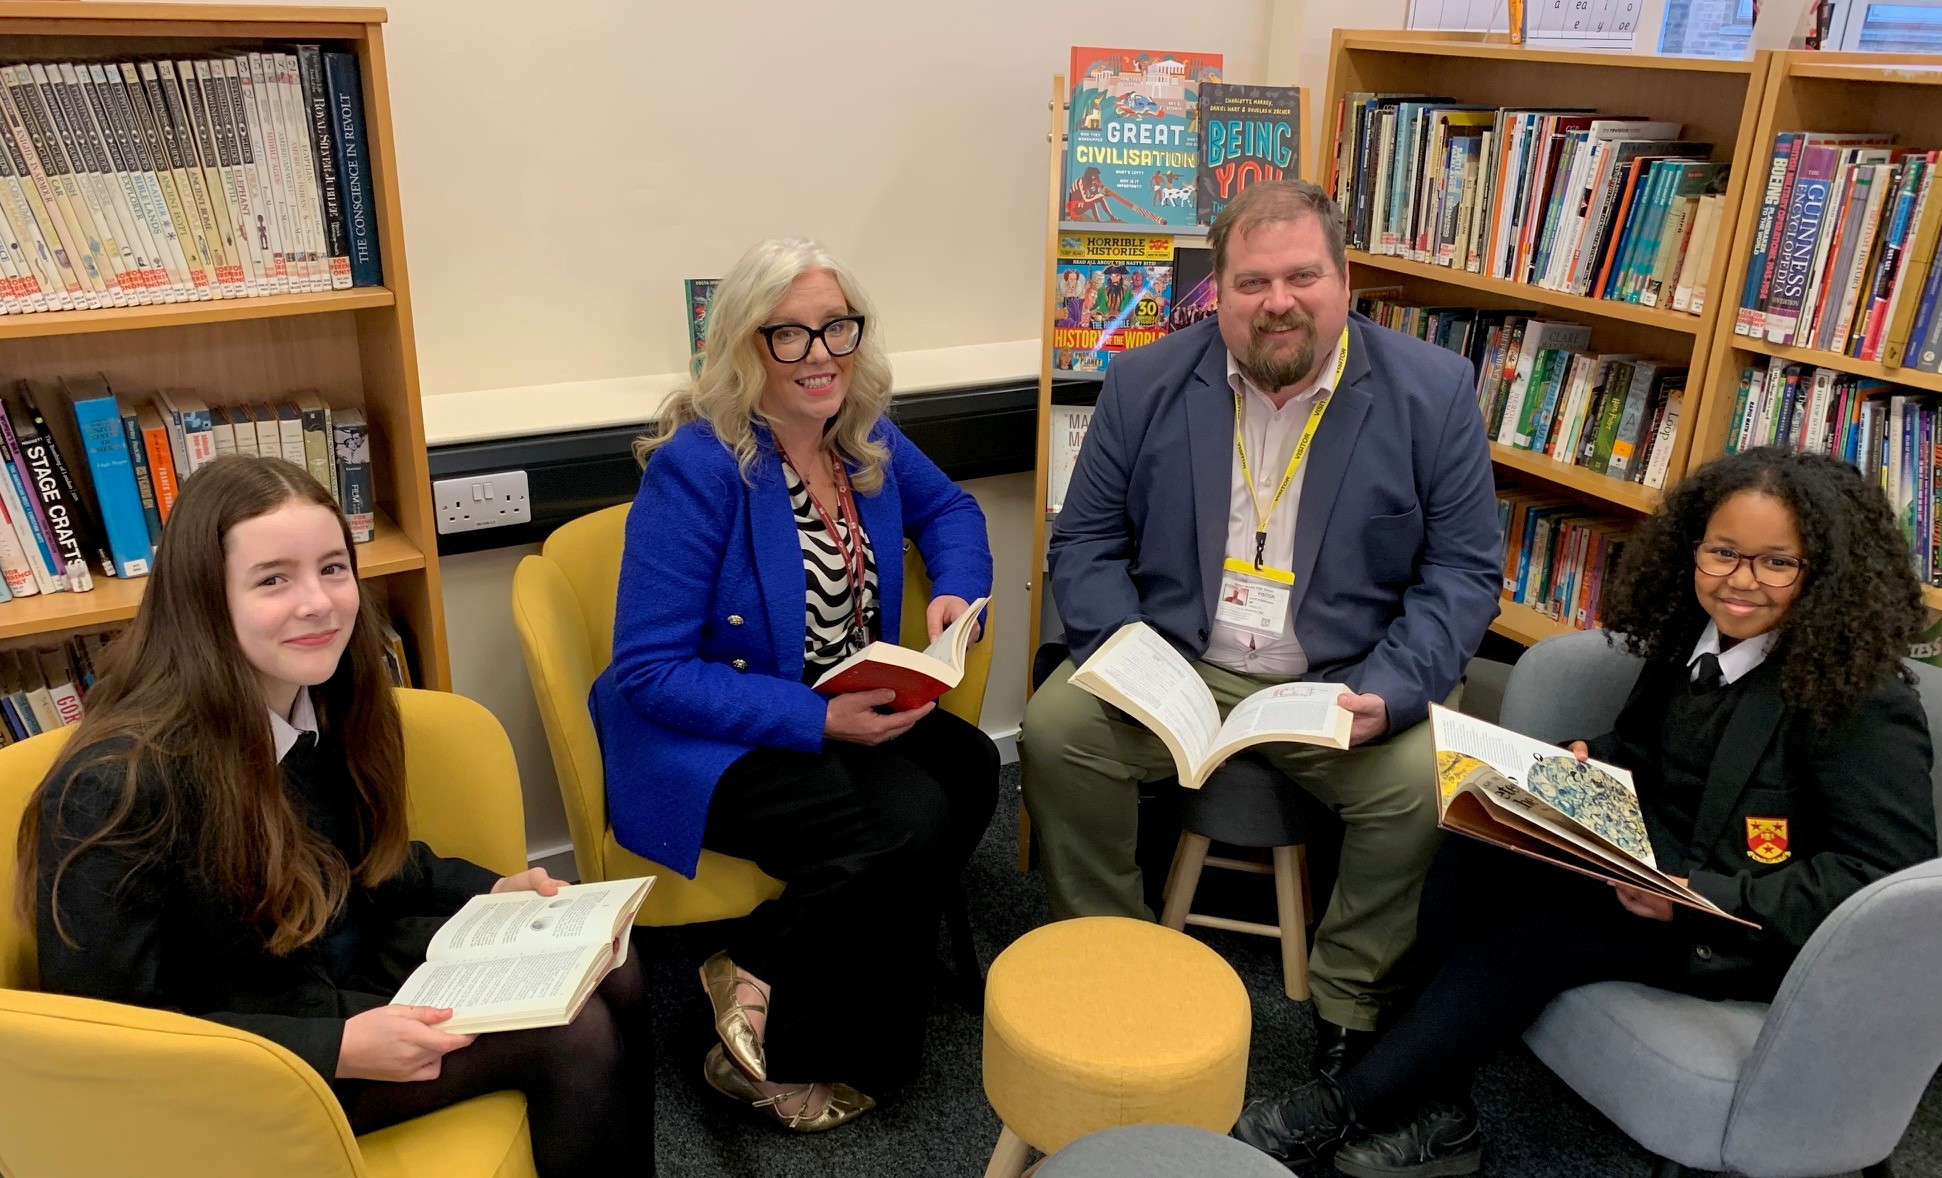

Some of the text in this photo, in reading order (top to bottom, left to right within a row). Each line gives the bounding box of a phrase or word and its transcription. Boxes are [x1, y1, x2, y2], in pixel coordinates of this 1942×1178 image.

[1576, 1, 1588, 10] ea
[1574, 19, 1580, 29] e
[1619, 21, 1631, 31] oe
[1225, 97, 1253, 105] CHARLOTTE
[1228, 105, 1240, 113] HART
[313, 98, 326, 134] ROYAL
[1107, 121, 1185, 146] GREAT
[1208, 120, 1292, 168] BEING
[16, 129, 34, 159] KNIGHTS
[31, 161, 38, 170] IN
[35, 172, 53, 203] ARMOUR
[38, 147, 55, 177] GUIDES
[68, 144, 82, 172] GUIDES
[81, 144, 96, 171] GUIDES
[320, 134, 332, 172] SILVER
[1076, 145, 1198, 169] CIVILISATION
[51, 180, 64, 197] CAR
[64, 177, 78, 197] FISH
[224, 171, 238, 204] REPTILE
[235, 169, 251, 216] ELEPHANT
[340, 93, 369, 264] THE CONSCIENCE IN REVOLT
[121, 175, 143, 220] EXPLORER
[134, 175, 161, 235] BIBLE LANDS
[148, 175, 167, 217] WEATHER
[161, 175, 188, 236] ANCIENT EGYPT
[191, 171, 213, 231] ANCIENT ROME
[325, 174, 339, 217] JUBILEE
[1760, 157, 1789, 253] BOEING PLANEMAKER
[1087, 238, 1145, 247] HORRIBLE
[1087, 247, 1145, 256] HISTORIES
[1754, 231, 1764, 255] WORLD
[1774, 184, 1808, 294] ENCYCLOPEDIA
[1784, 184, 1826, 297] GUINNESS
[1138, 301, 1157, 316] 30
[1055, 329, 1105, 348] HISTORY
[1114, 336, 1124, 345] THE
[1092, 321, 1103, 329] THE
[1104, 320, 1130, 329] HOBLE
[1336, 347, 1347, 374] VISITOR
[1493, 325, 1512, 381] INDEPENDENCE
[1507, 392, 1519, 425] HEROIC
[1660, 411, 1679, 441] Loop
[47, 443, 63, 466] Bombing
[1237, 441, 1247, 470] VISITOR
[1294, 433, 1311, 460] VISITOR
[159, 467, 171, 491] FRANCE
[1275, 476, 1290, 502] VISITOR
[351, 484, 360, 503] FILM
[27, 446, 83, 571] STAGE CRAFTS
